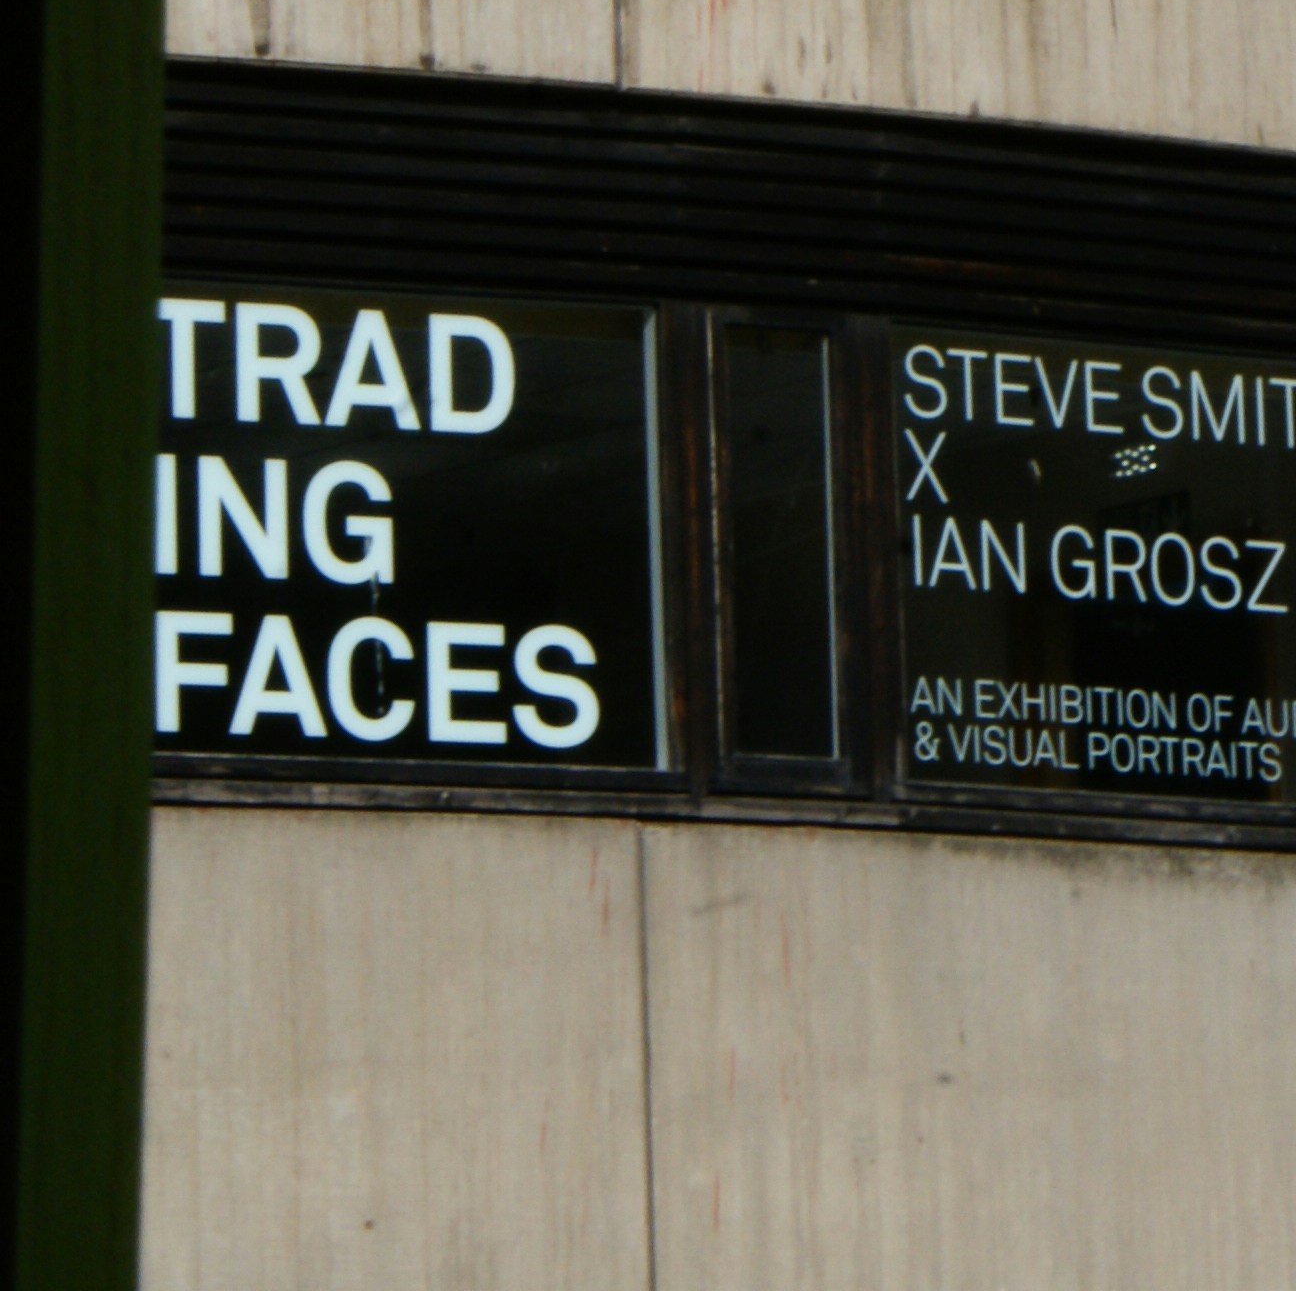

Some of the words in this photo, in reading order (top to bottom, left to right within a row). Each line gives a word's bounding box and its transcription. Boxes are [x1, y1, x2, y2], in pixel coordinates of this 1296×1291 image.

[157, 299, 515, 434] TRAD
[904, 344, 1124, 435] STEVE
[904, 428, 949, 504] X
[155, 454, 394, 585] ING
[911, 512, 1027, 594] IAN
[1050, 524, 1289, 614] GROSZ
[155, 610, 600, 749] FACES
[910, 675, 963, 718] AN
[974, 679, 1177, 729] EXHIBITION
[1186, 692, 1234, 734] OF
[913, 721, 940, 762] &
[947, 725, 1080, 770] VISUAL
[1088, 733, 1283, 783] PORTRAITS
